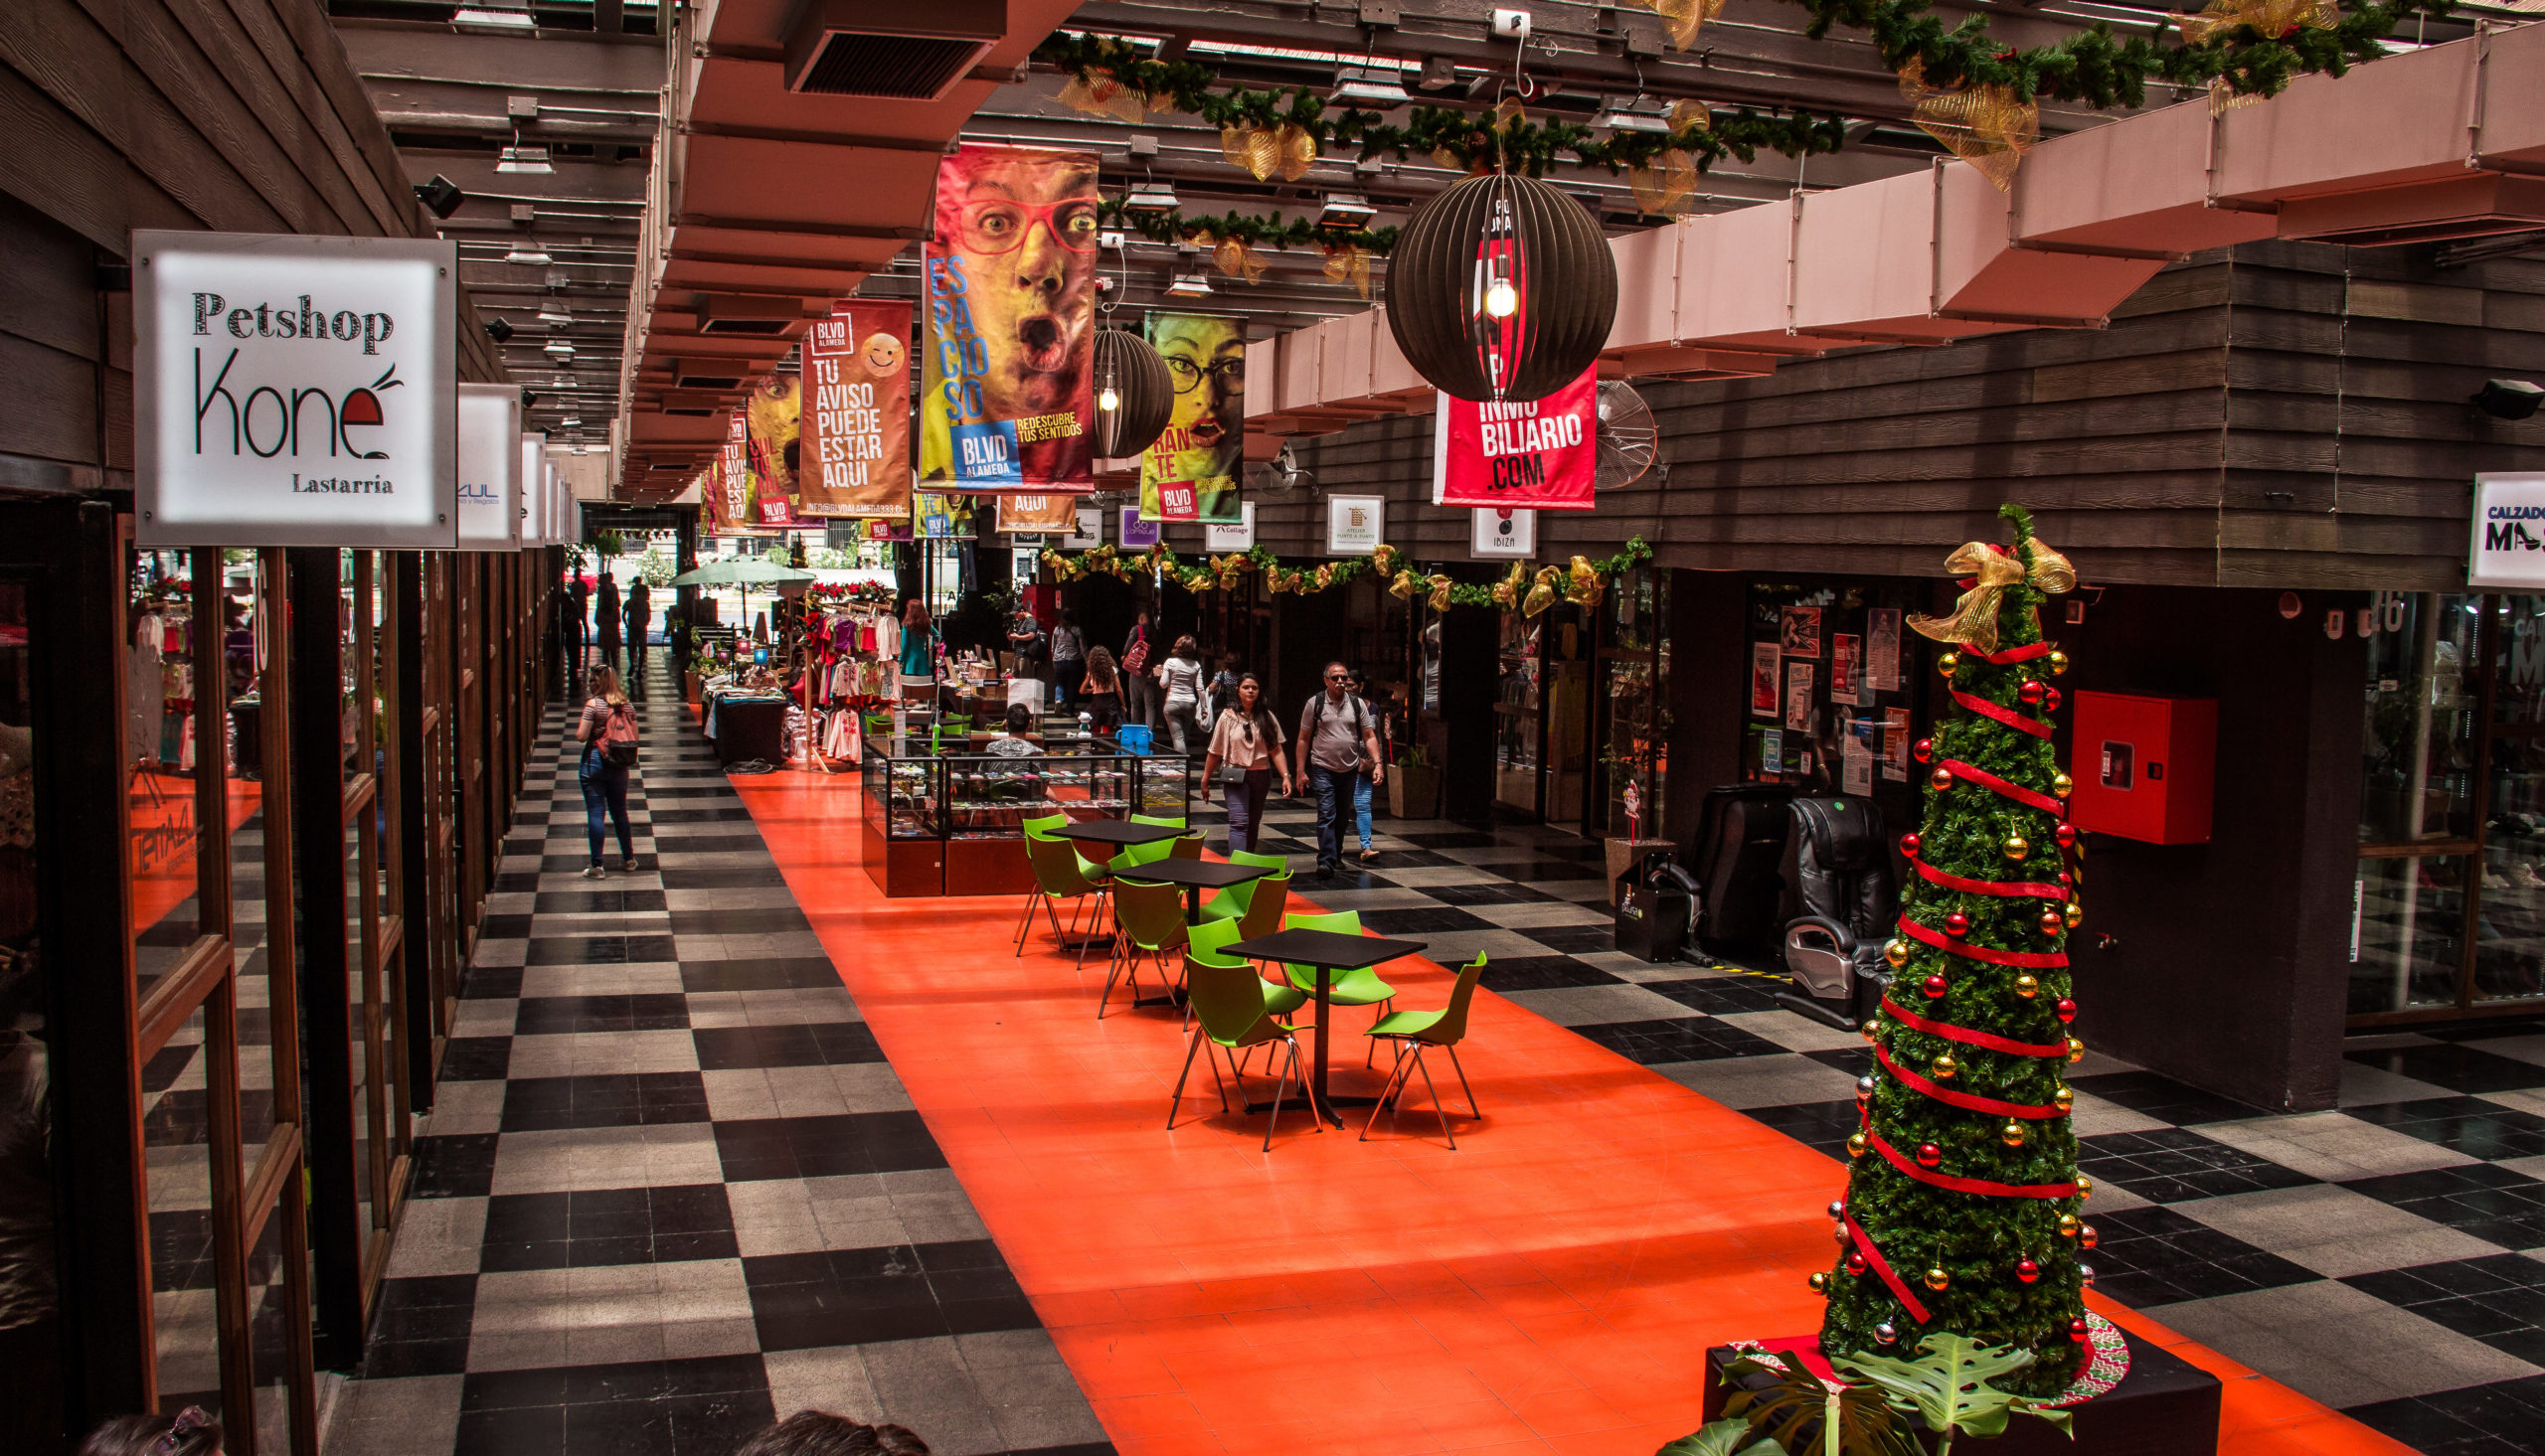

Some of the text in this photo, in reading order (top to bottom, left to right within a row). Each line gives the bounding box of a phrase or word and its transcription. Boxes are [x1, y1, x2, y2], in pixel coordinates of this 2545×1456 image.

[929, 255, 968, 296] ES
[192, 292, 394, 355] Petshop
[933, 298, 975, 338] PA
[817, 322, 845, 340] BLVD
[818, 338, 845, 347] ALAMEDA
[939, 337, 990, 379] CIO
[812, 359, 839, 386] TU
[816, 383, 874, 411] AVISO
[943, 379, 982, 420] SO
[818, 408, 882, 437] PUEDE
[1016, 411, 1077, 431] REDESCUBRE
[1018, 423, 1083, 443] TUS SENTIDOS
[1480, 412, 1584, 458] BILIARIO
[724, 444, 740, 461] TU
[748, 437, 776, 457] CUL
[820, 435, 884, 463] ESTAR
[961, 434, 1008, 466] BLVD
[752, 456, 771, 475] TU
[823, 460, 869, 489] AQUI
[966, 462, 1010, 478] ALAMEDA
[1154, 454, 1177, 479] TE
[1487, 452, 1546, 491] .COM
[292, 473, 394, 494] Lastarria
[756, 474, 784, 496] RAL
[1015, 495, 1047, 512] AQUI
[1163, 488, 1191, 508] BLVD
[764, 502, 786, 517] BLVD
[2488, 506, 2545, 520] CALZAD
[1493, 537, 1515, 548] IBIZA
